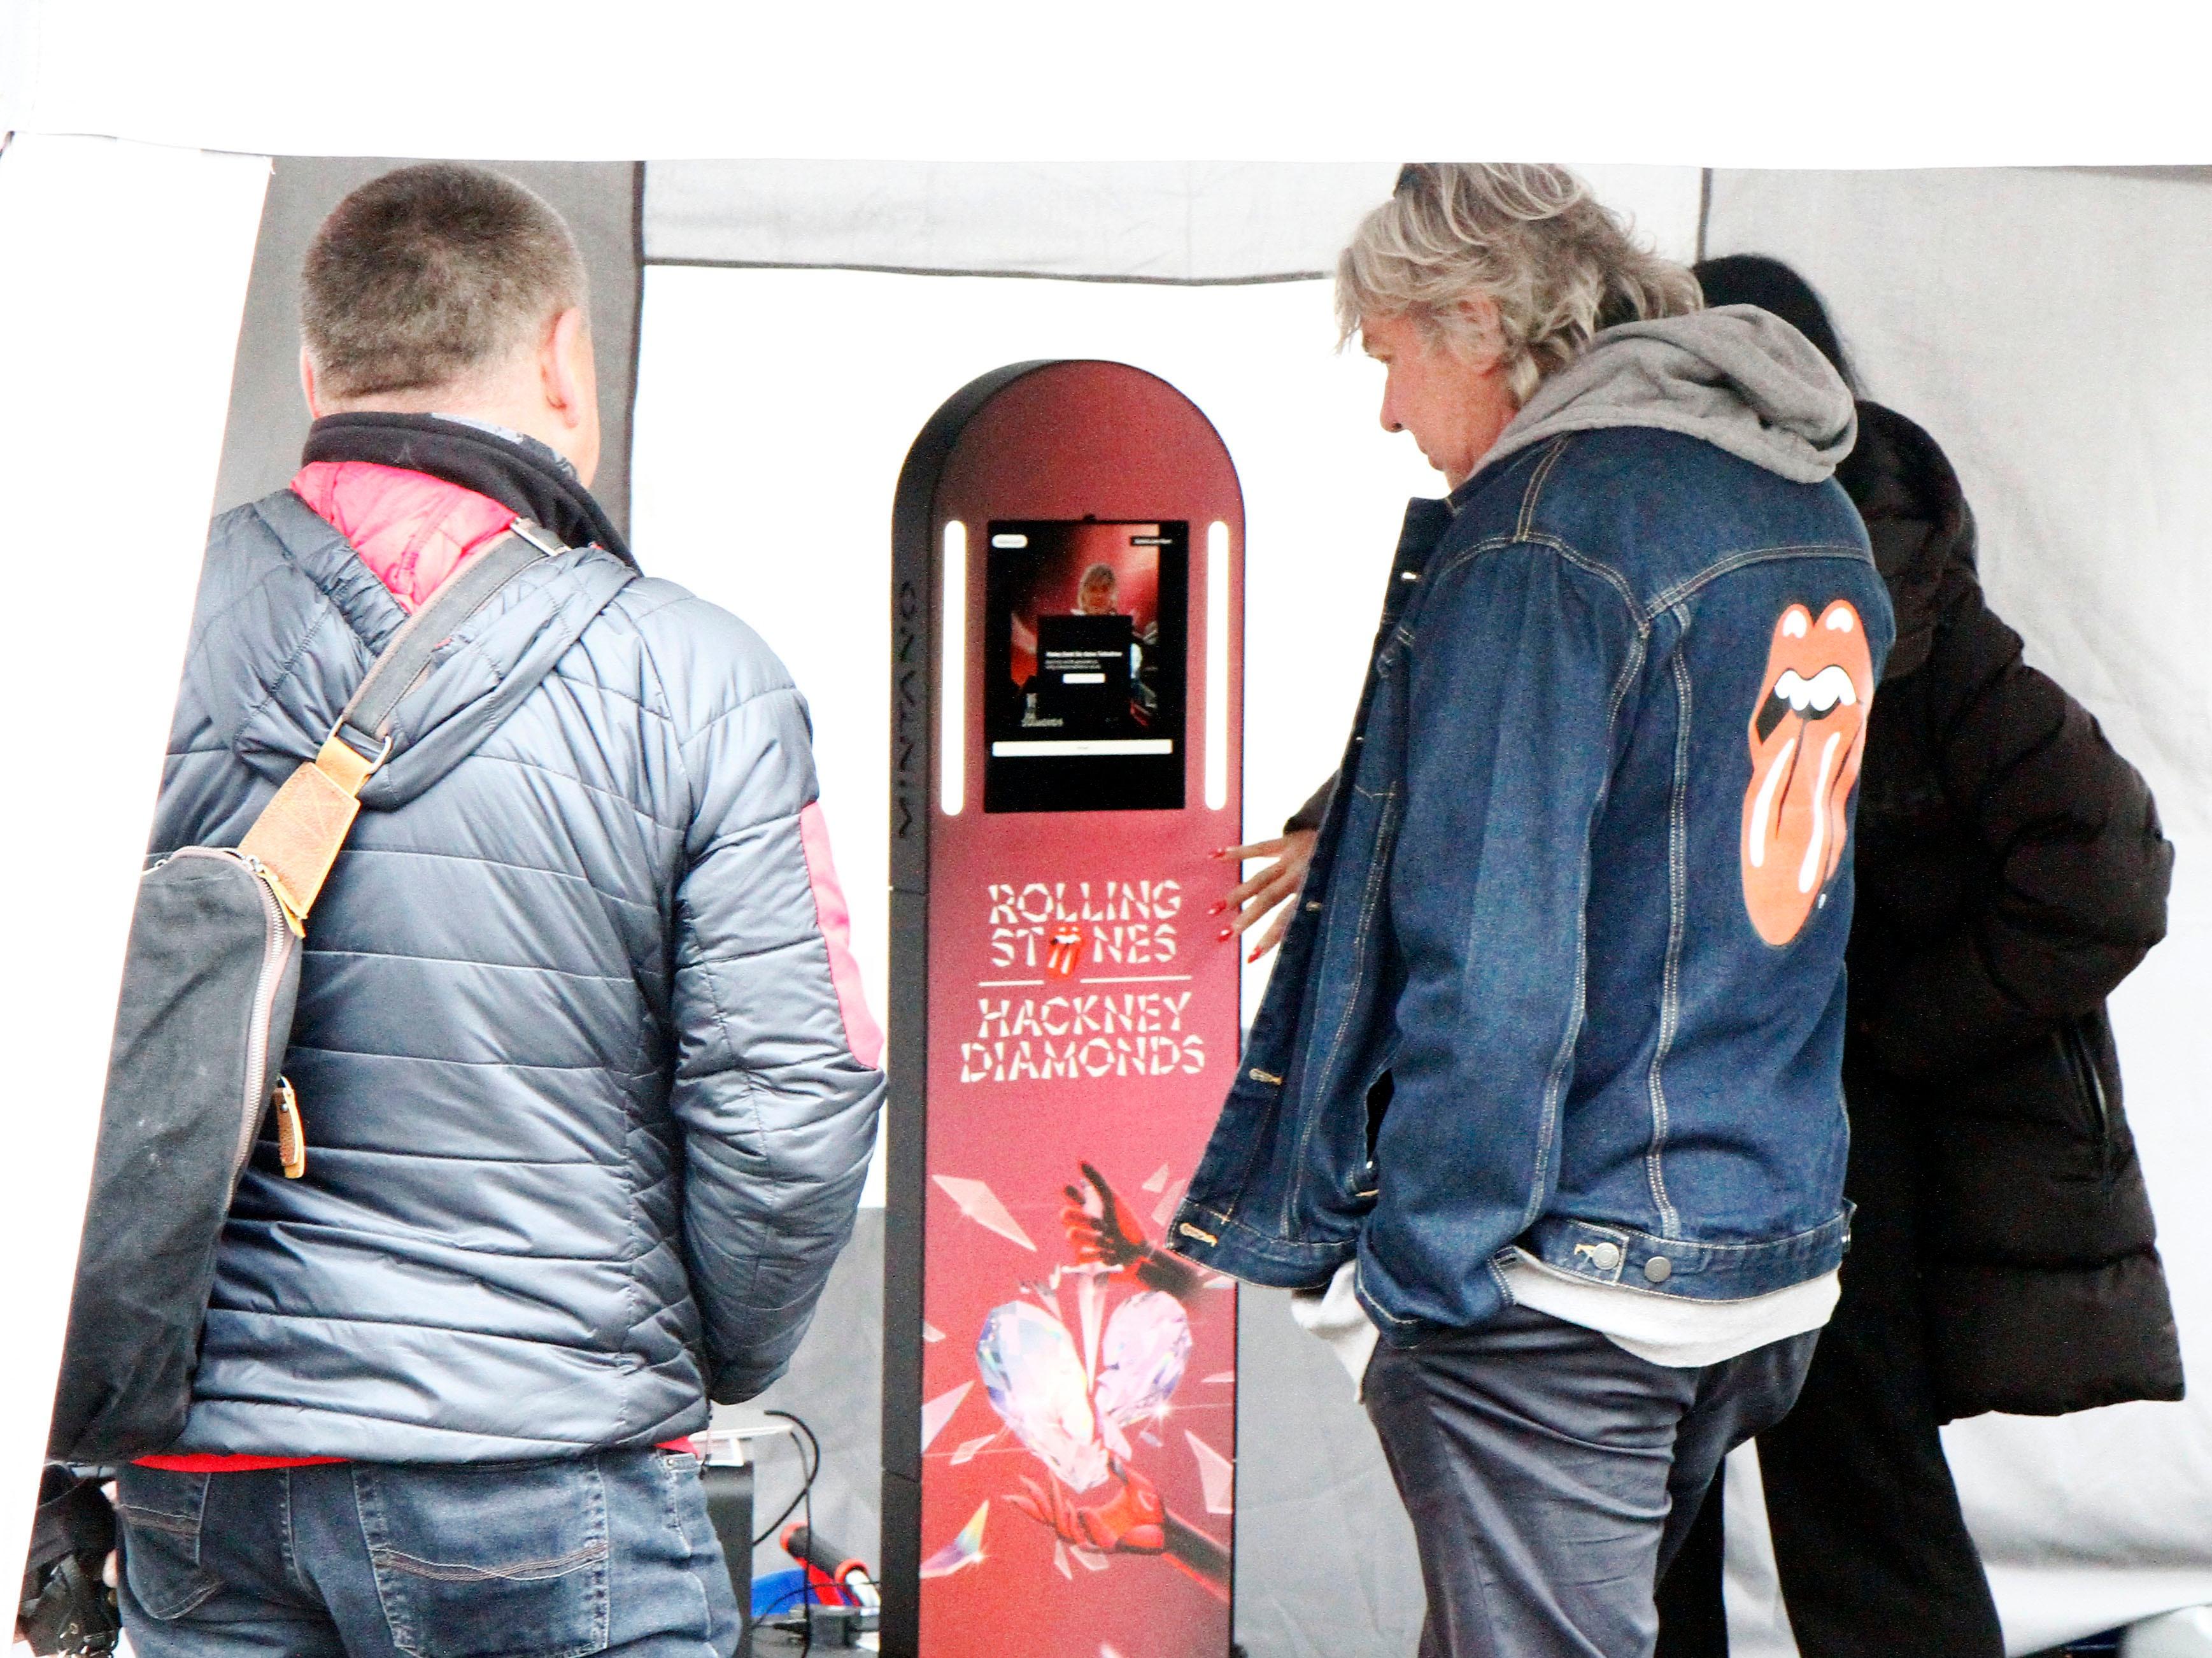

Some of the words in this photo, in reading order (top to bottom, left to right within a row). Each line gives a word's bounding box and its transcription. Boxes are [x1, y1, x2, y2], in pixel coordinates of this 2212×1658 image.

[988, 879, 1182, 925] ROLLING
[991, 923, 1177, 968] STNES
[977, 991, 1193, 1038] HACKNEY
[960, 1033, 1205, 1084] DIAMONDS
